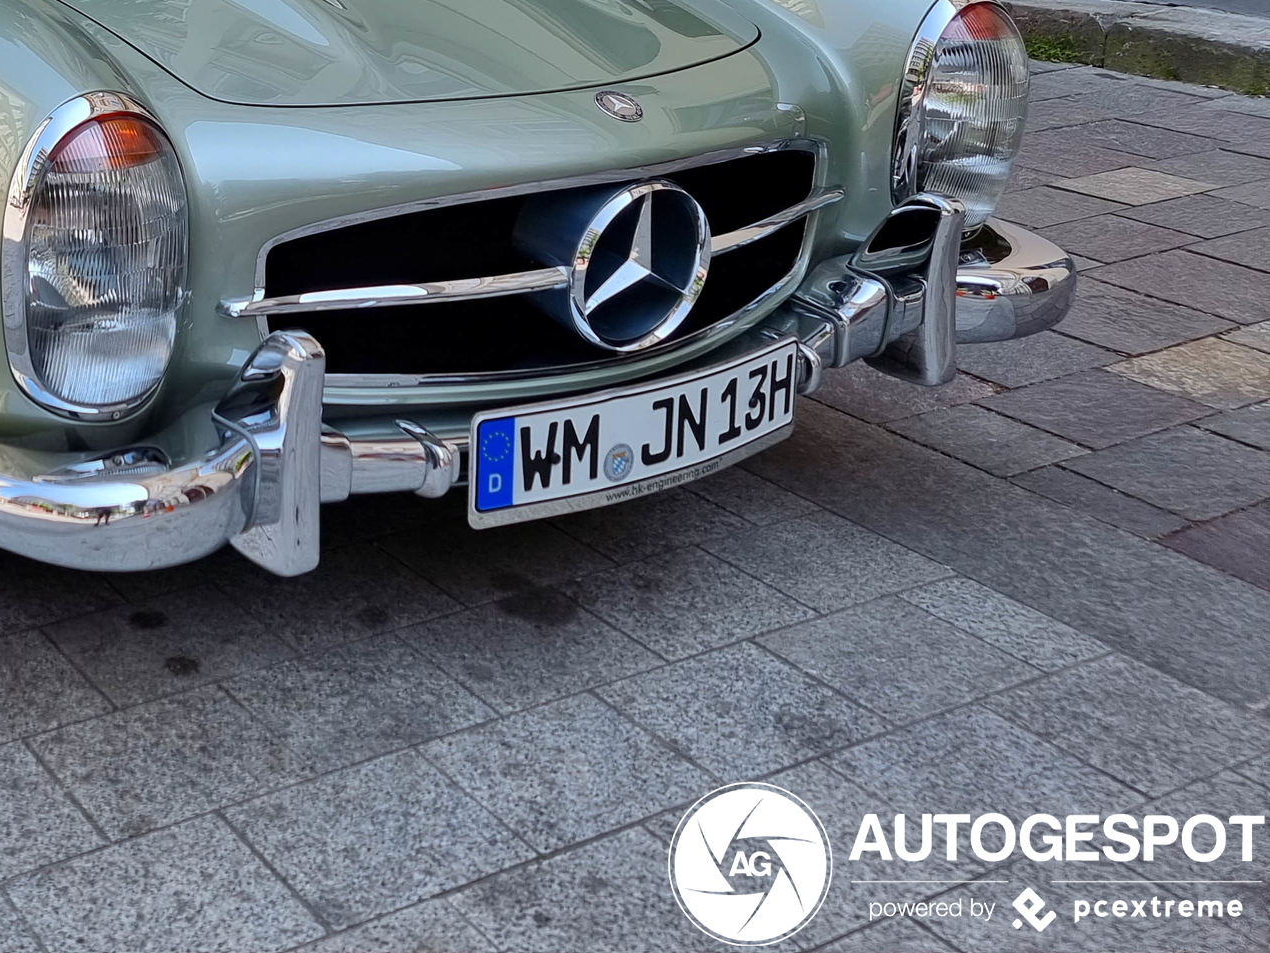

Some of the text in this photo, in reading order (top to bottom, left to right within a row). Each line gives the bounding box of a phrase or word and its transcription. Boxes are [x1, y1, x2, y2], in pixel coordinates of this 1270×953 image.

[520, 413, 600, 492] WM
[641, 387, 708, 466] JN
[717, 353, 794, 446] 13H
[488, 472, 503, 494] D
